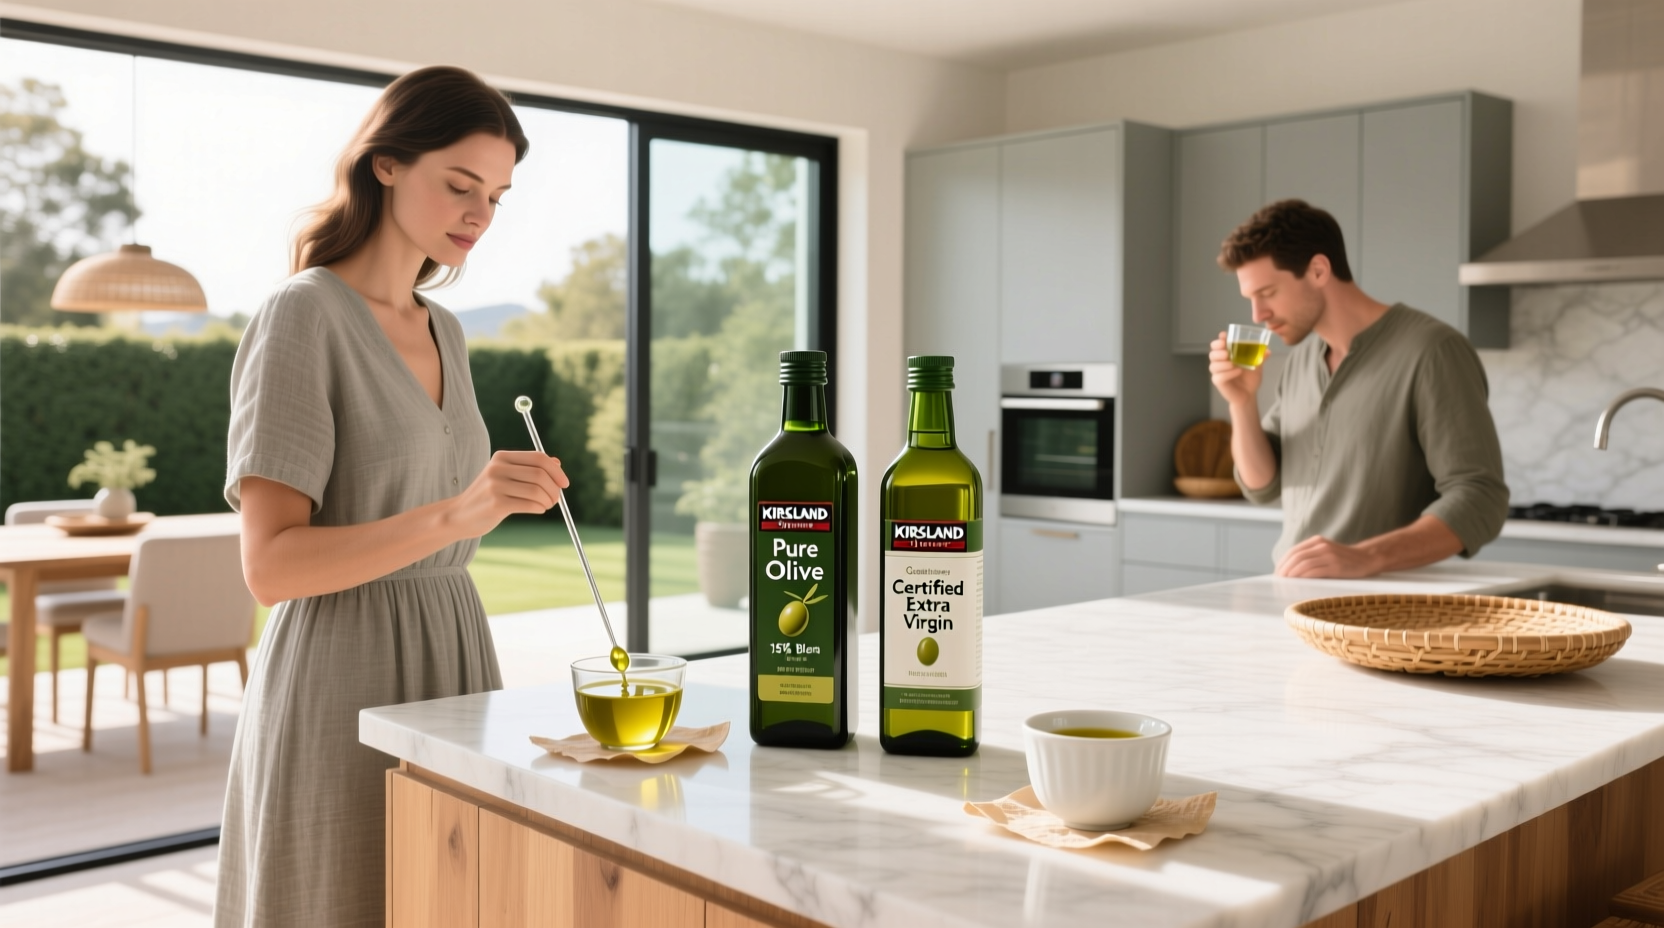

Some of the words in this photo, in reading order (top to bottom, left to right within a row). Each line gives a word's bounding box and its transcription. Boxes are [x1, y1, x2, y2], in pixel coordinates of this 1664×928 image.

[773, 538, 818, 557] Pure
[765, 560, 824, 580] Olive
[892, 579, 964, 596] Certified
[906, 597, 950, 612] Extra
[903, 614, 953, 633] Virgin
